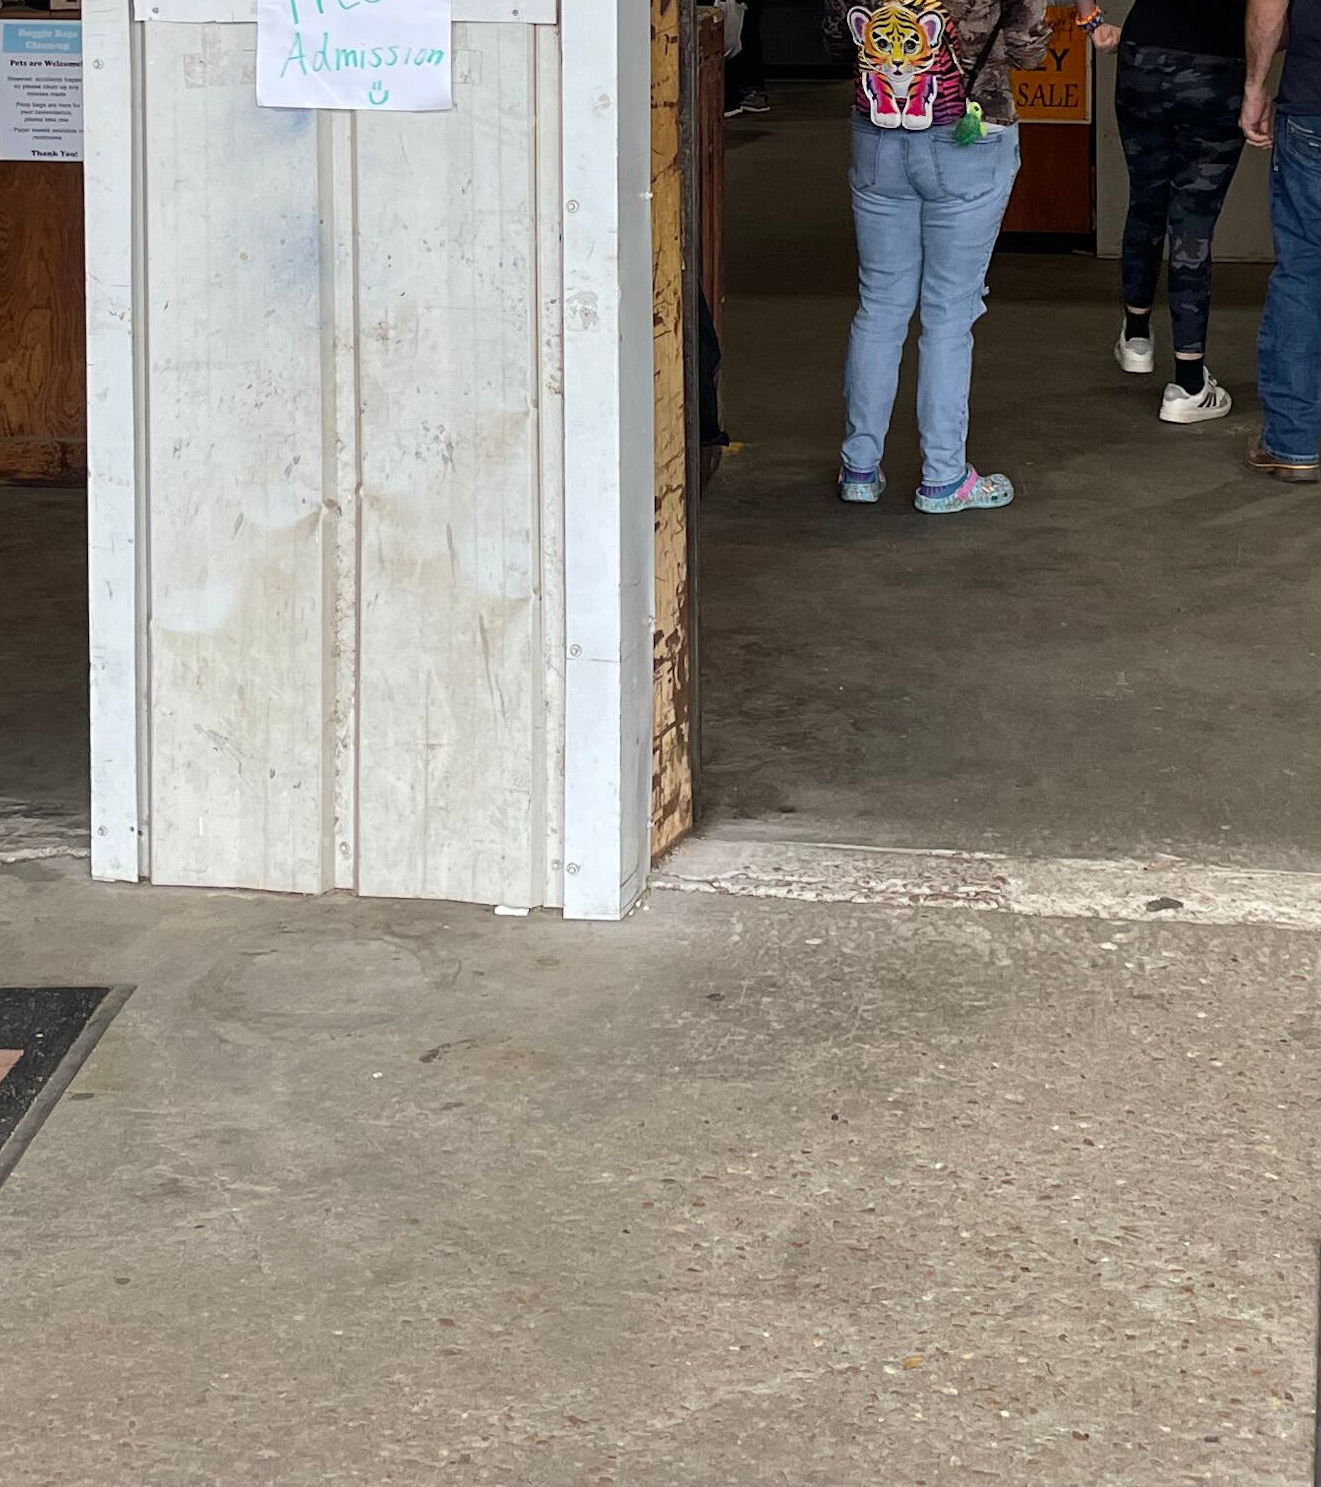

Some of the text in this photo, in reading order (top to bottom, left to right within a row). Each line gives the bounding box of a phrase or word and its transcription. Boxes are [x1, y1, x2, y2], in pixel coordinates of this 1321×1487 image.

[280, 32, 445, 79] Admission
[1017, 83, 1079, 107] SALE
[31, 149, 58, 157] Thank
